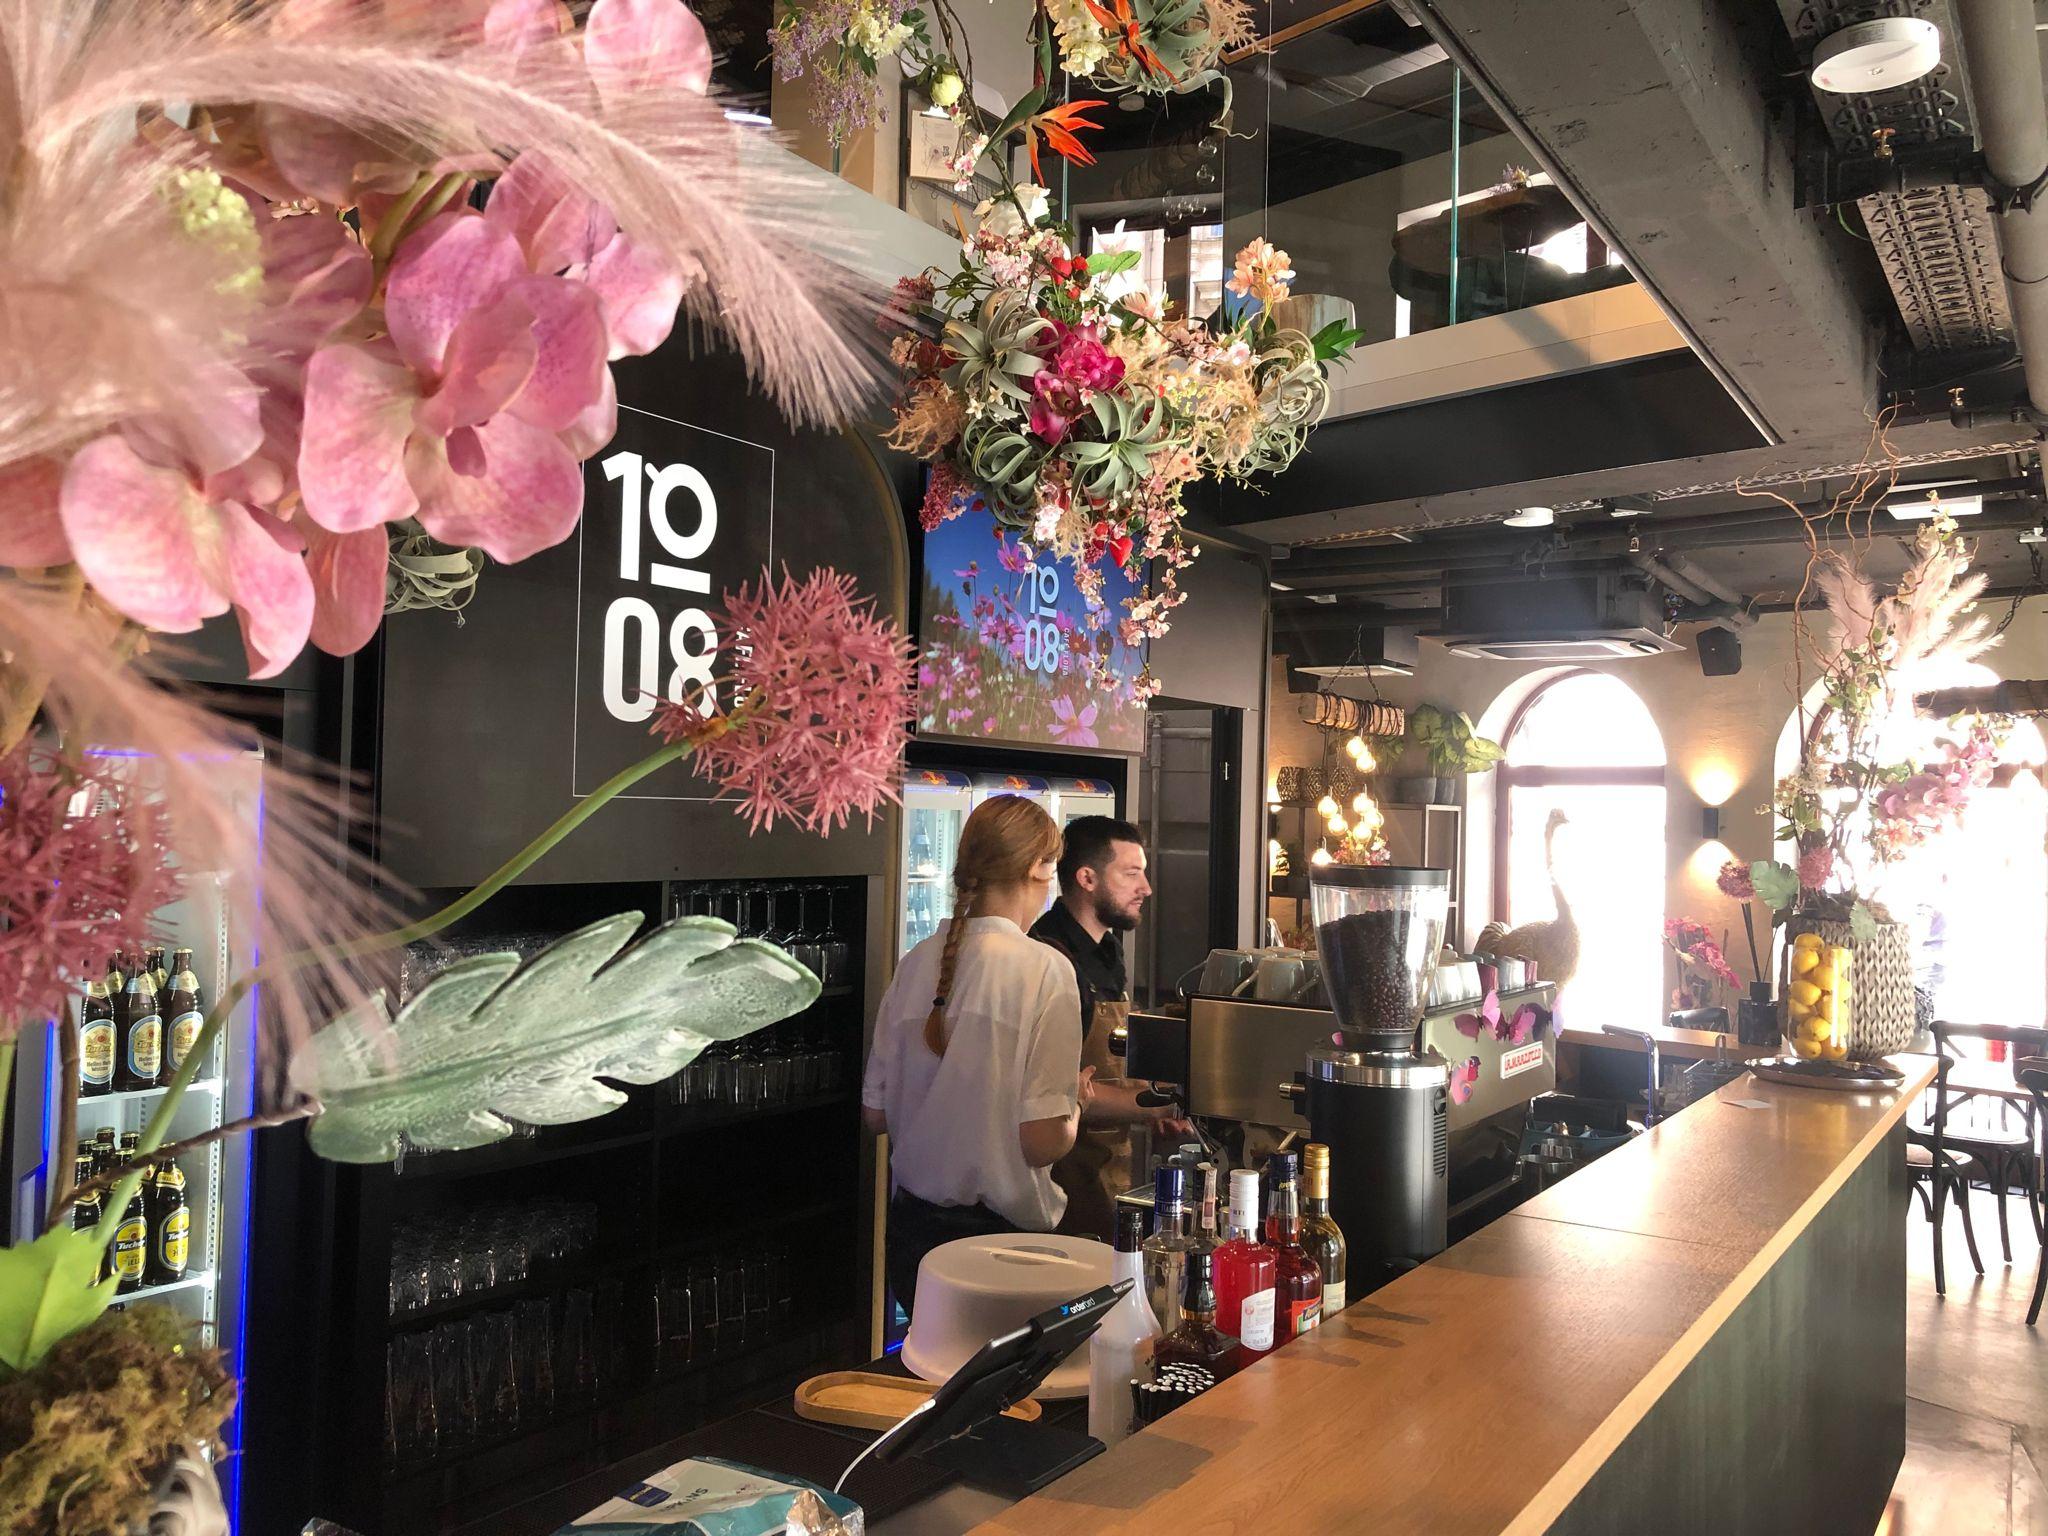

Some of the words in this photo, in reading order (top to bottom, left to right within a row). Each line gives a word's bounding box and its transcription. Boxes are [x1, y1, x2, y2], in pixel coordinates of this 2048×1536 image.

[601, 451, 718, 581] 10
[603, 597, 718, 722] 08
[1025, 620, 1059, 673] 08
